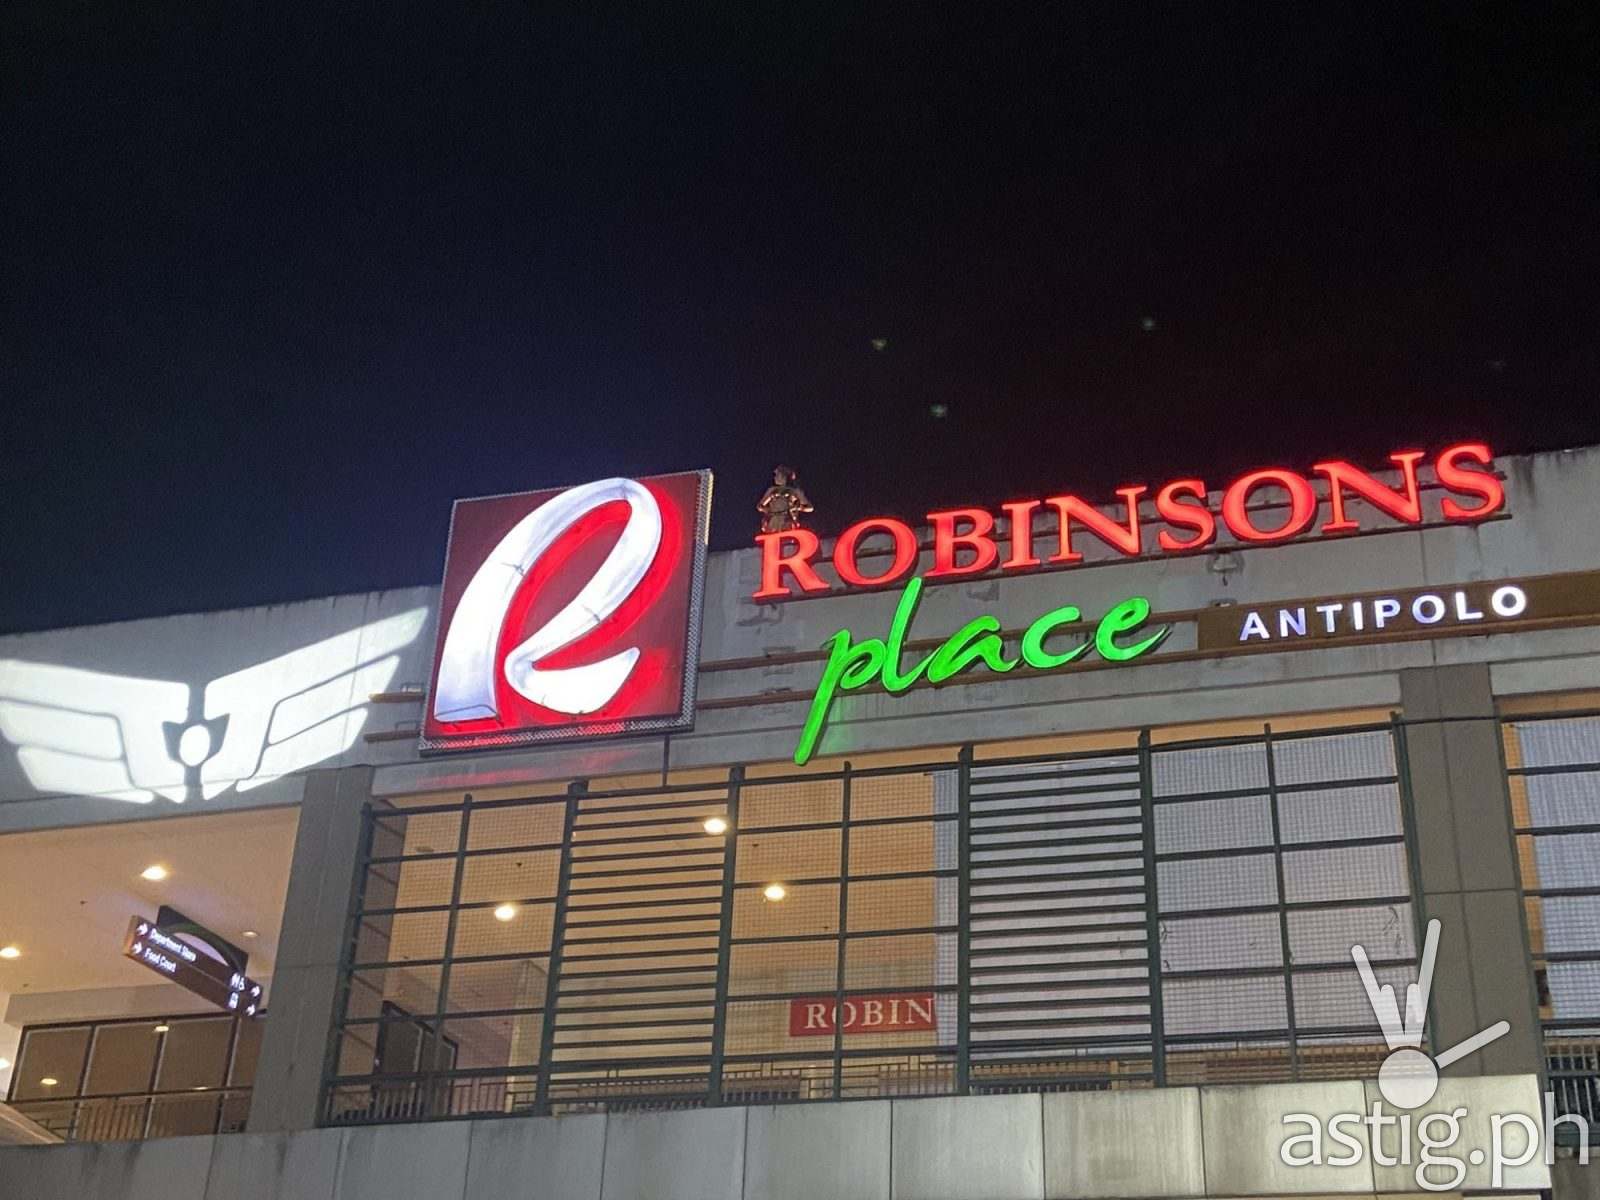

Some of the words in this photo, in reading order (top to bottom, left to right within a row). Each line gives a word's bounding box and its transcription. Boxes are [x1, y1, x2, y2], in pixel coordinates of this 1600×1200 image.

[753, 443, 1506, 599] ROBINSONS
[1239, 585, 1527, 641] ANTIPOLO
[794, 576, 1168, 766] place
[803, 997, 935, 1029] ROBIN
